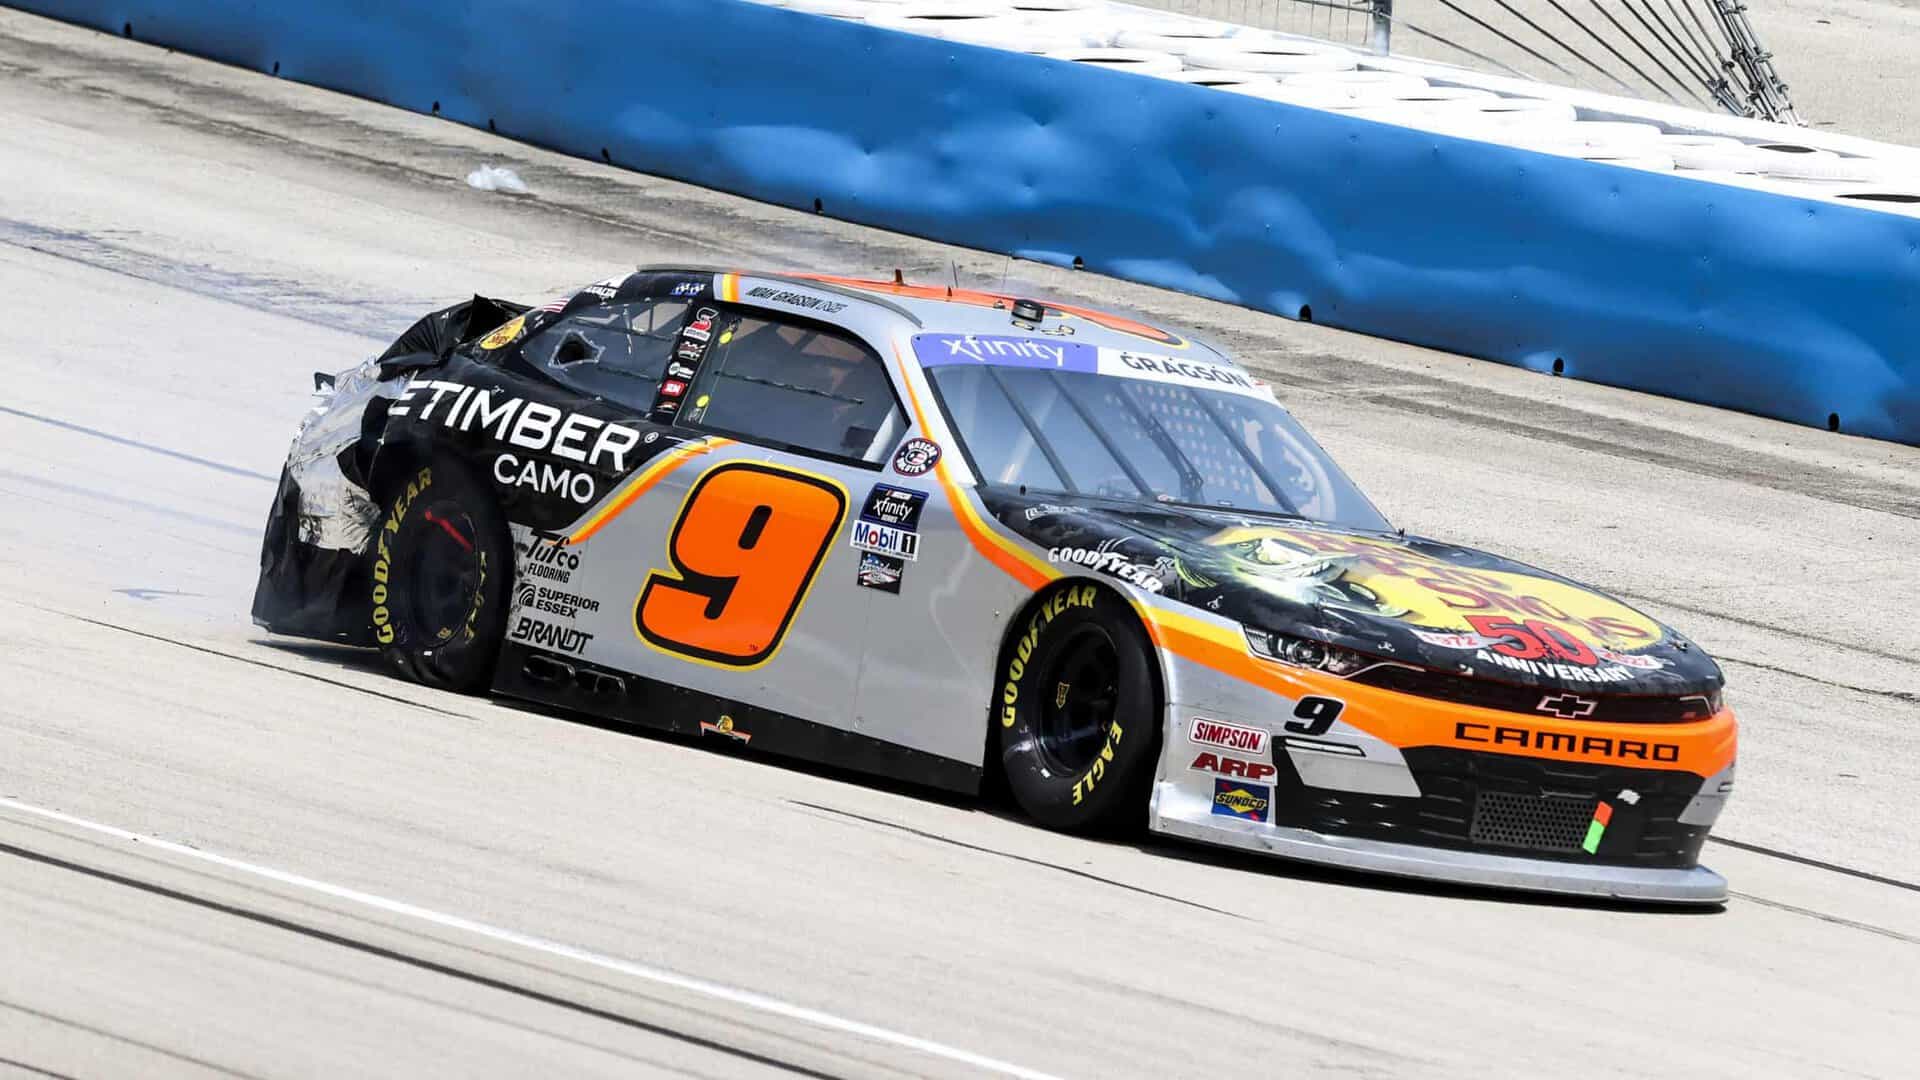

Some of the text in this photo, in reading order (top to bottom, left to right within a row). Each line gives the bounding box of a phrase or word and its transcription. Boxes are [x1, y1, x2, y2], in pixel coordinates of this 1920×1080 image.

[940, 334, 1065, 368] xfinity
[1120, 352, 1250, 388] GRAGSON
[493, 453, 595, 504] CAMO
[872, 497, 913, 521] xfinity
[372, 466, 433, 644] GOODYEAR
[525, 528, 580, 571] Tufco
[854, 522, 899, 551] Mobil
[527, 562, 570, 584] FLOORING
[631, 458, 851, 672] 9
[1047, 547, 1164, 593] GOODYEAR
[535, 599, 578, 619] ESSEX
[537, 587, 600, 612] SUPERIOR
[511, 617, 594, 655] BRANDT
[1463, 615, 1600, 667] 50
[1001, 585, 1098, 729] GOODYEAR
[1476, 649, 1635, 683] ANNIVERSARY
[1284, 695, 1345, 737] 9
[1194, 721, 1262, 751] SIMPSON
[1455, 722, 1680, 763] CAMARO
[1072, 719, 1124, 806] EAGLE
[1189, 751, 1276, 780] ARP
[1215, 792, 1267, 811] SUNOCO
